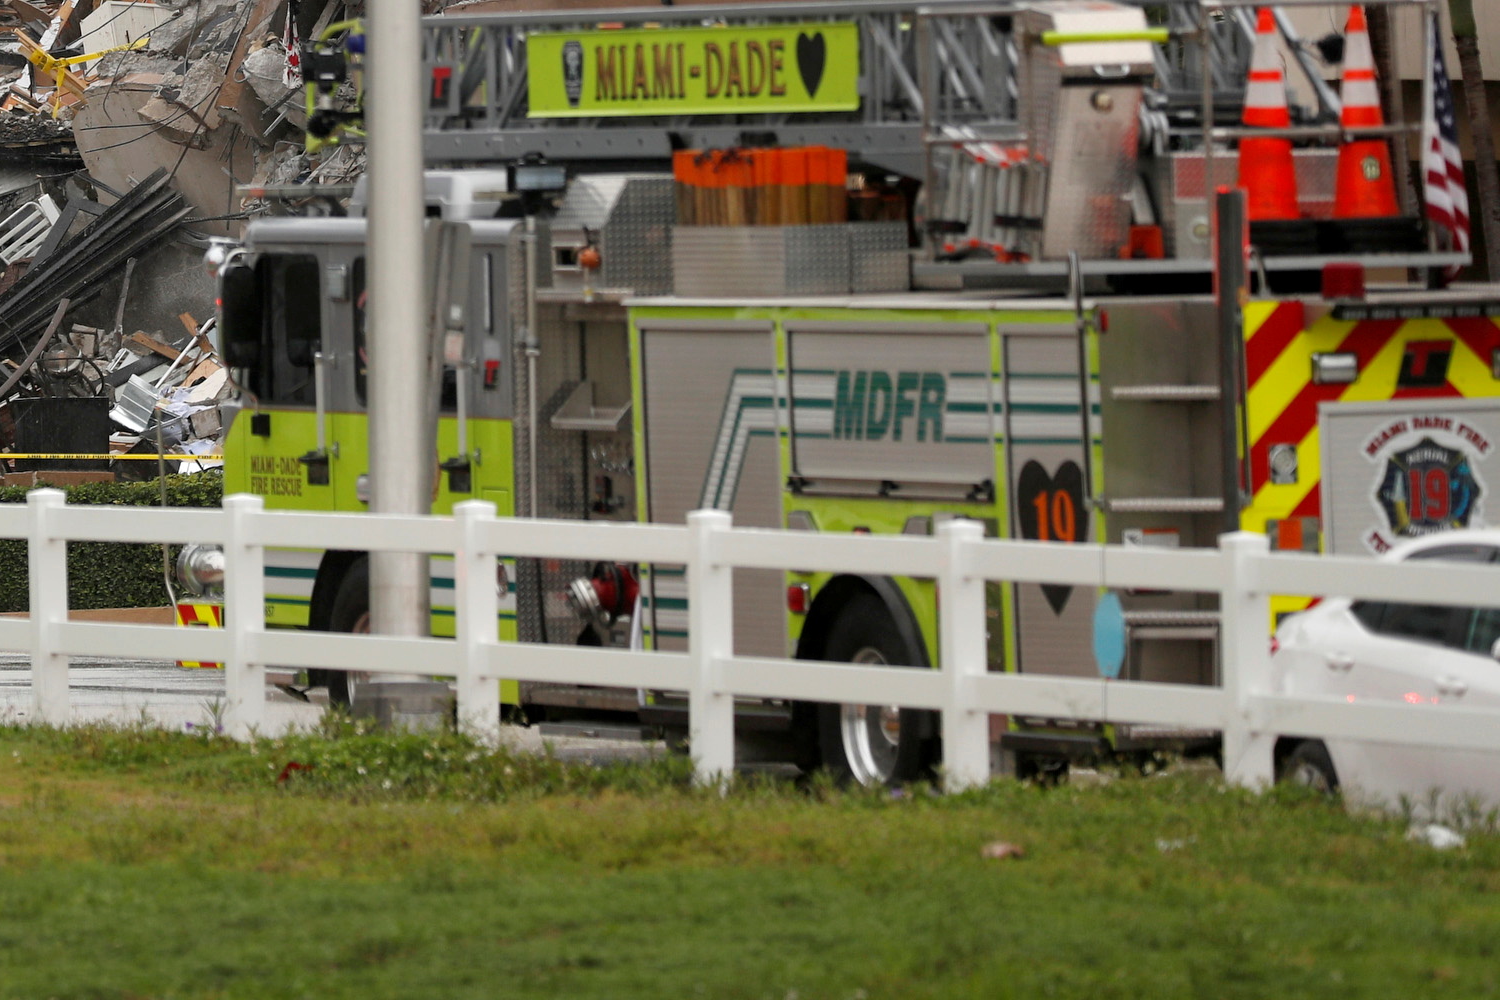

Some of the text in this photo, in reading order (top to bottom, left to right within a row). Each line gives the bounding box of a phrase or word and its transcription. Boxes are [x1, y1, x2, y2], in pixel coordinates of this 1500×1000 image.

[595, 39, 786, 101] MIAMI-DADE
[833, 370, 946, 442] MDFR
[1366, 416, 1490, 456] MIAMI DADE FIRE
[250, 455, 302, 476] MIAMI-DADE
[250, 476, 303, 497] FIRE RESCUE
[1408, 468, 1450, 521] 19
